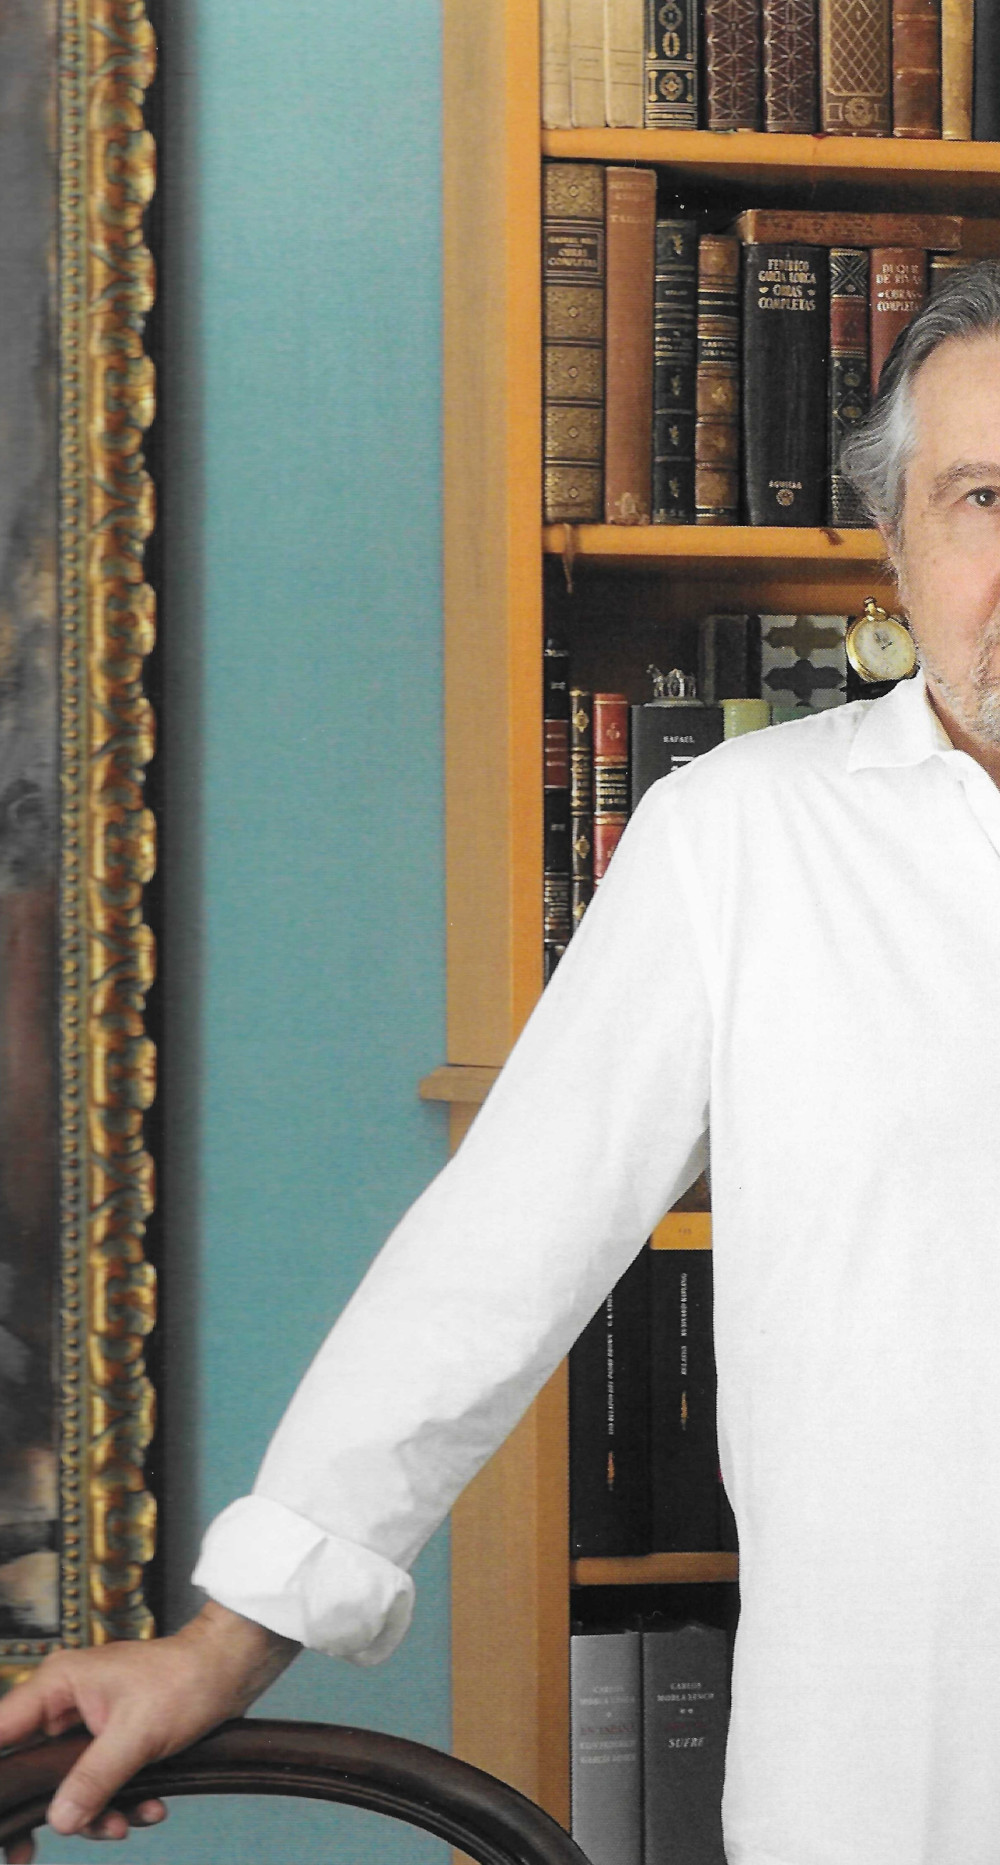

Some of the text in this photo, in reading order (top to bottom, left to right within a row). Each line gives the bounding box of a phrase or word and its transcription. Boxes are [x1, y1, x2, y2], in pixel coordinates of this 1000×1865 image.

[767, 258, 810, 272] FEDERICO
[789, 271, 817, 284] LORCA
[876, 273, 891, 284] DE
[772, 284, 803, 297] OBRAS
[758, 296, 816, 311] COMPLETAS
[662, 735, 695, 744] RAFAEL
[680, 1272, 688, 1302] KIPLING
[668, 1736, 705, 1748] SUFRE
